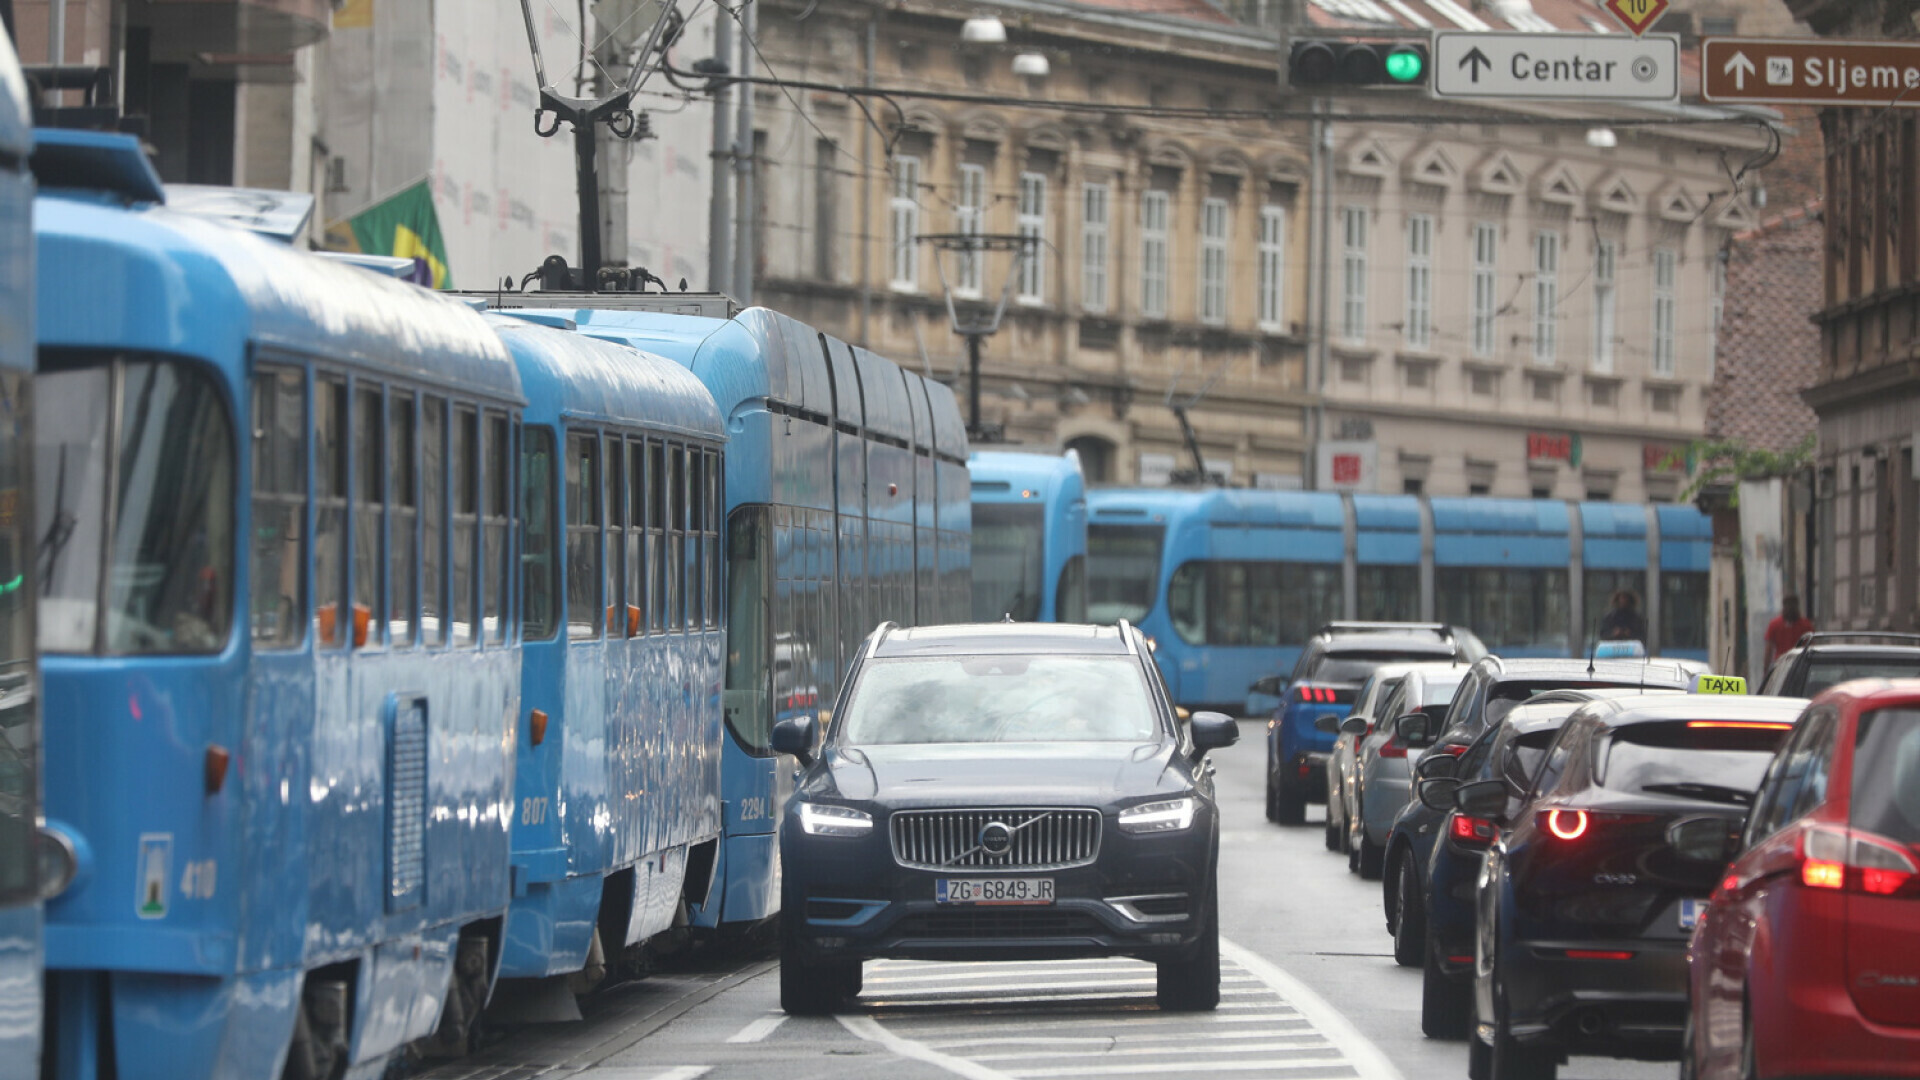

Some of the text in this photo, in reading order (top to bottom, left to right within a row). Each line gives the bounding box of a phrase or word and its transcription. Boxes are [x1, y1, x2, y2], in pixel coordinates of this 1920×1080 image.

[1628, 0, 1647, 14] 10
[1511, 52, 1617, 81] Centar
[1804, 57, 1920, 94] Sljeme
[1703, 678, 1740, 692] TAXI
[521, 797, 548, 825] 807
[741, 797, 765, 821] 2294
[949, 881, 971, 899] ZG
